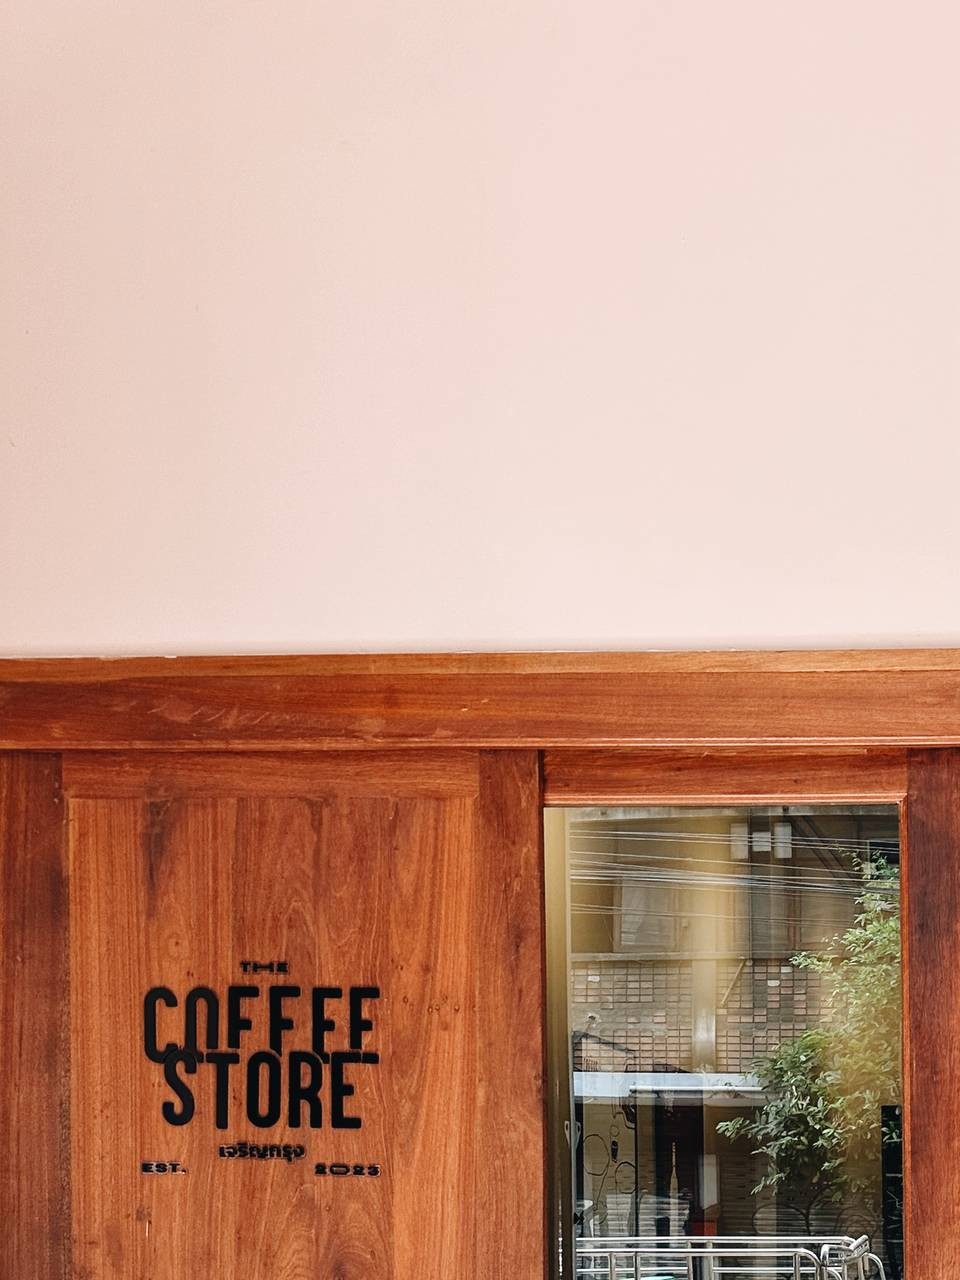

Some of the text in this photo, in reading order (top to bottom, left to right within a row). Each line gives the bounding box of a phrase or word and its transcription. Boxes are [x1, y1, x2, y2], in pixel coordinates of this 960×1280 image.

[240, 960, 289, 973] THE
[144, 986, 380, 1065] COFFEE
[162, 1051, 362, 1129] STORE
[141, 1163, 380, 1176] EST. 2023
